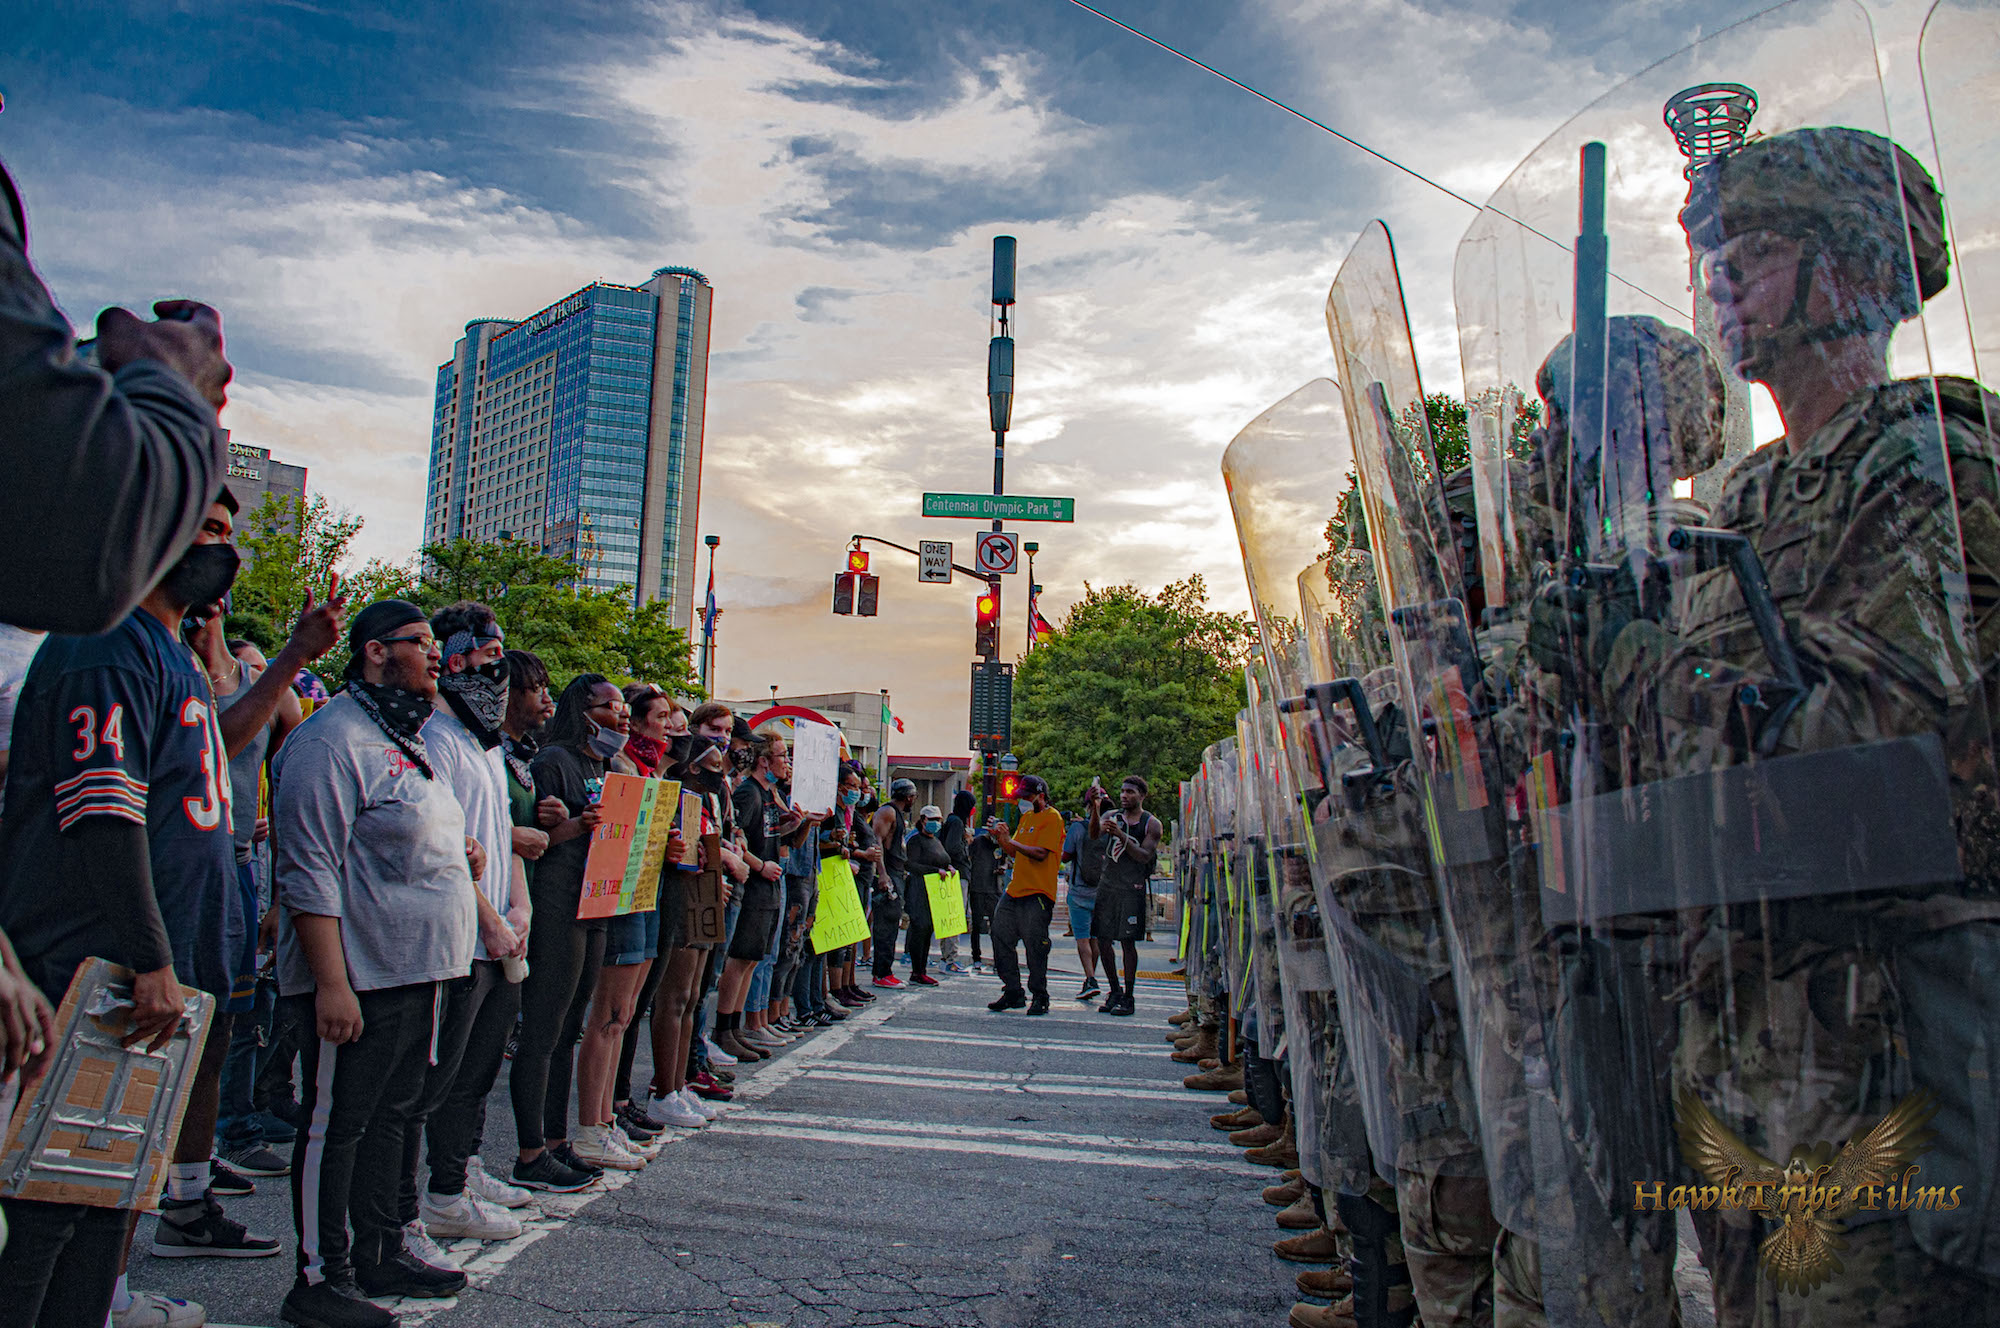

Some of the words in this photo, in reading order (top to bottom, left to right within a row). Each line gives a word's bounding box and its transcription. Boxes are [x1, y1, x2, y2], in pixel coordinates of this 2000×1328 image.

[228, 443, 261, 458] OMNI
[926, 498, 978, 512] Centennial
[983, 499, 1024, 516] Olympic
[1027, 502, 1049, 515] Park
[1053, 500, 1062, 508] DR
[925, 544, 946, 555] ONE
[925, 557, 946, 567] WAY
[69, 703, 124, 762] 34
